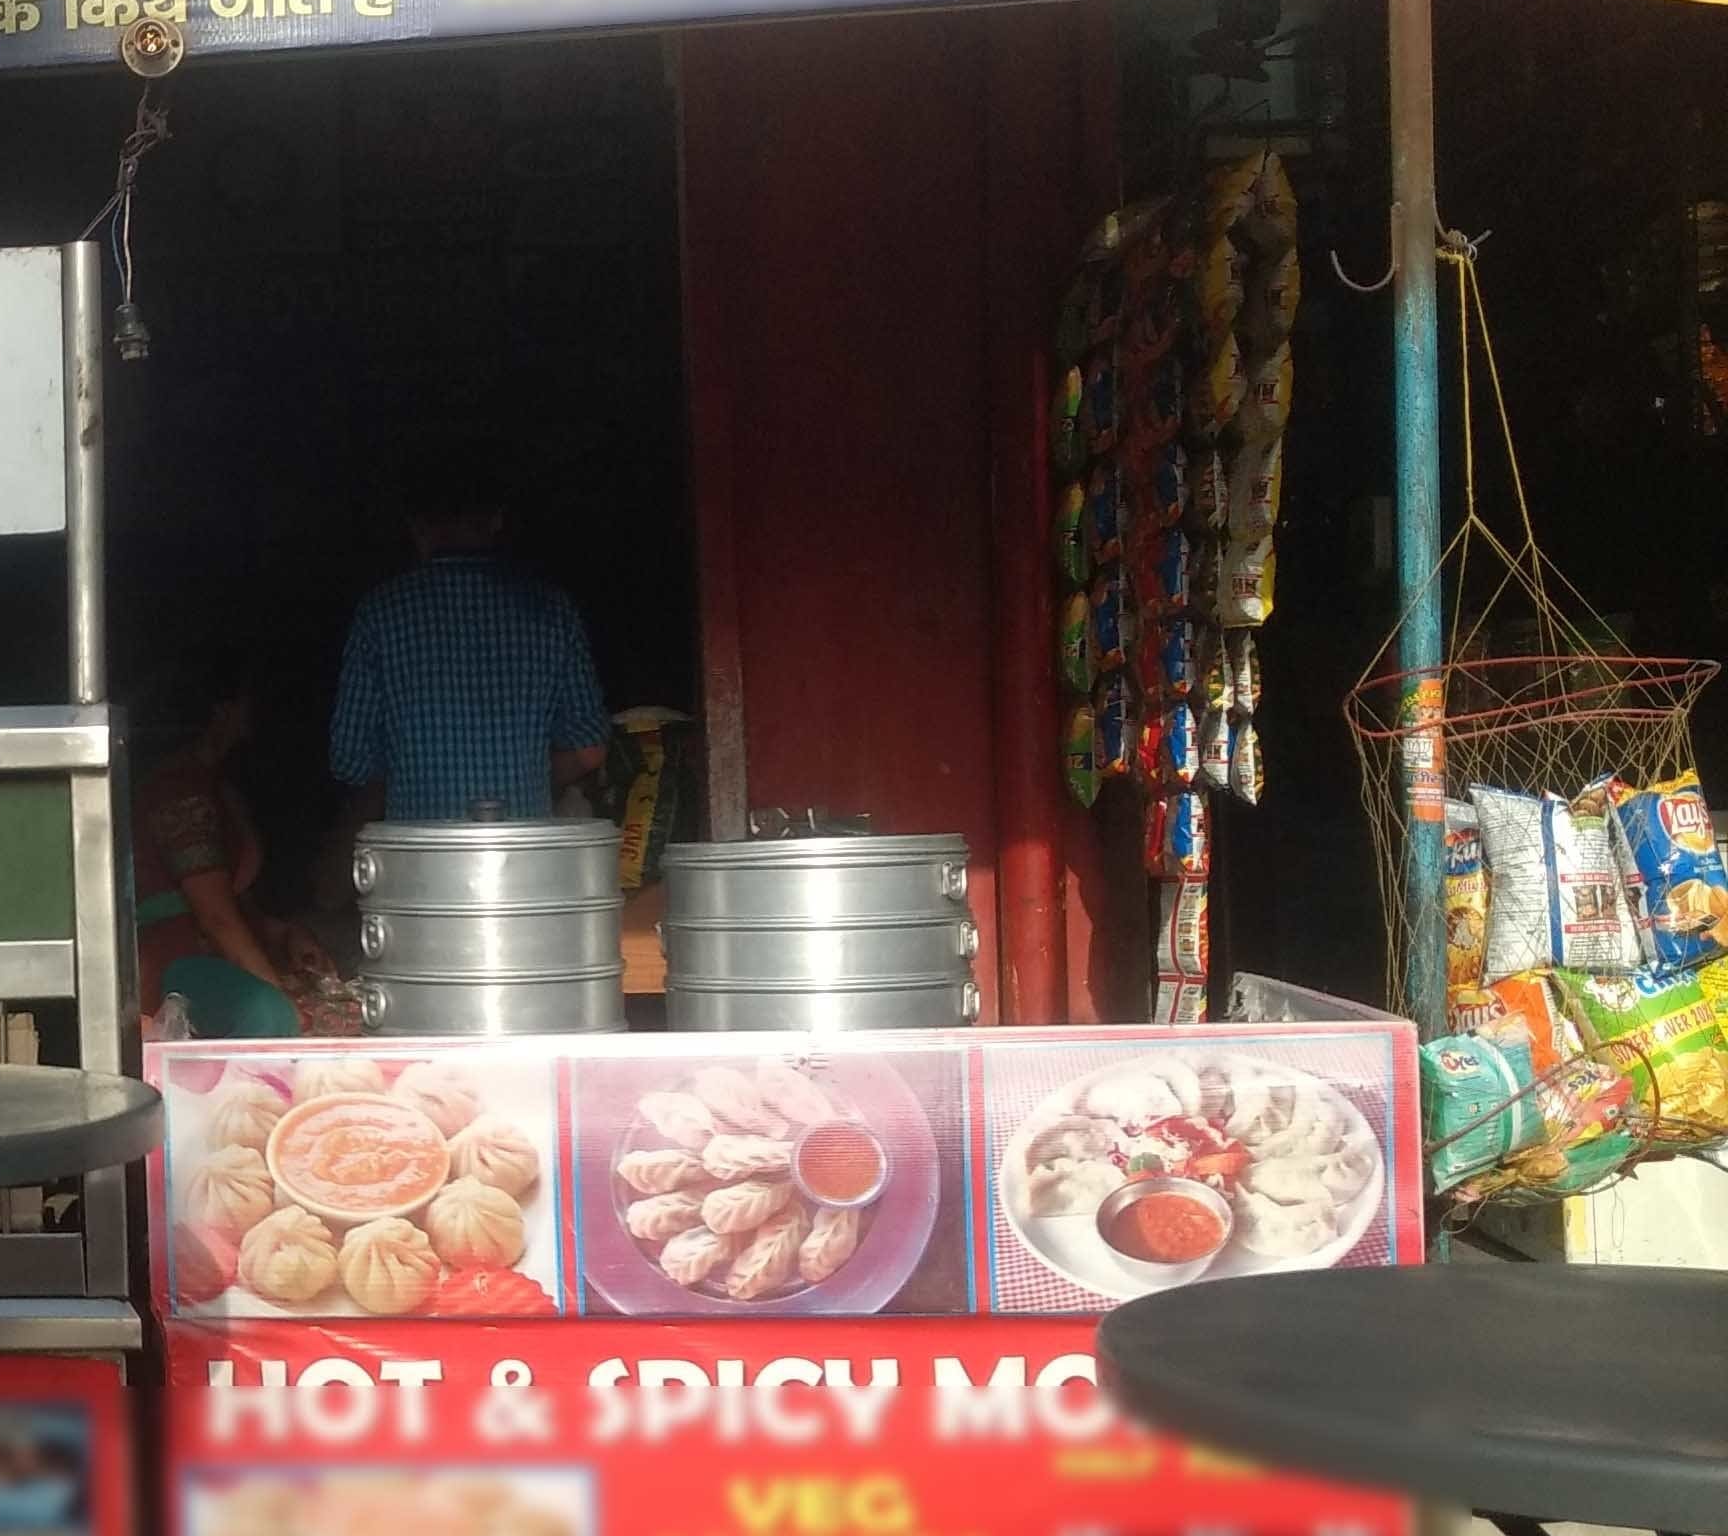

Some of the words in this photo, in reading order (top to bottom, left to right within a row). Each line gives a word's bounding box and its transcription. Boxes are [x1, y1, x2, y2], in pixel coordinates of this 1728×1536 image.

[1653, 1012, 1692, 1041] AVER
[206, 1356, 444, 1440] HOT
[478, 1359, 552, 1441] &
[584, 1356, 902, 1440] SPICY
[932, 1355, 1127, 1441] MO
